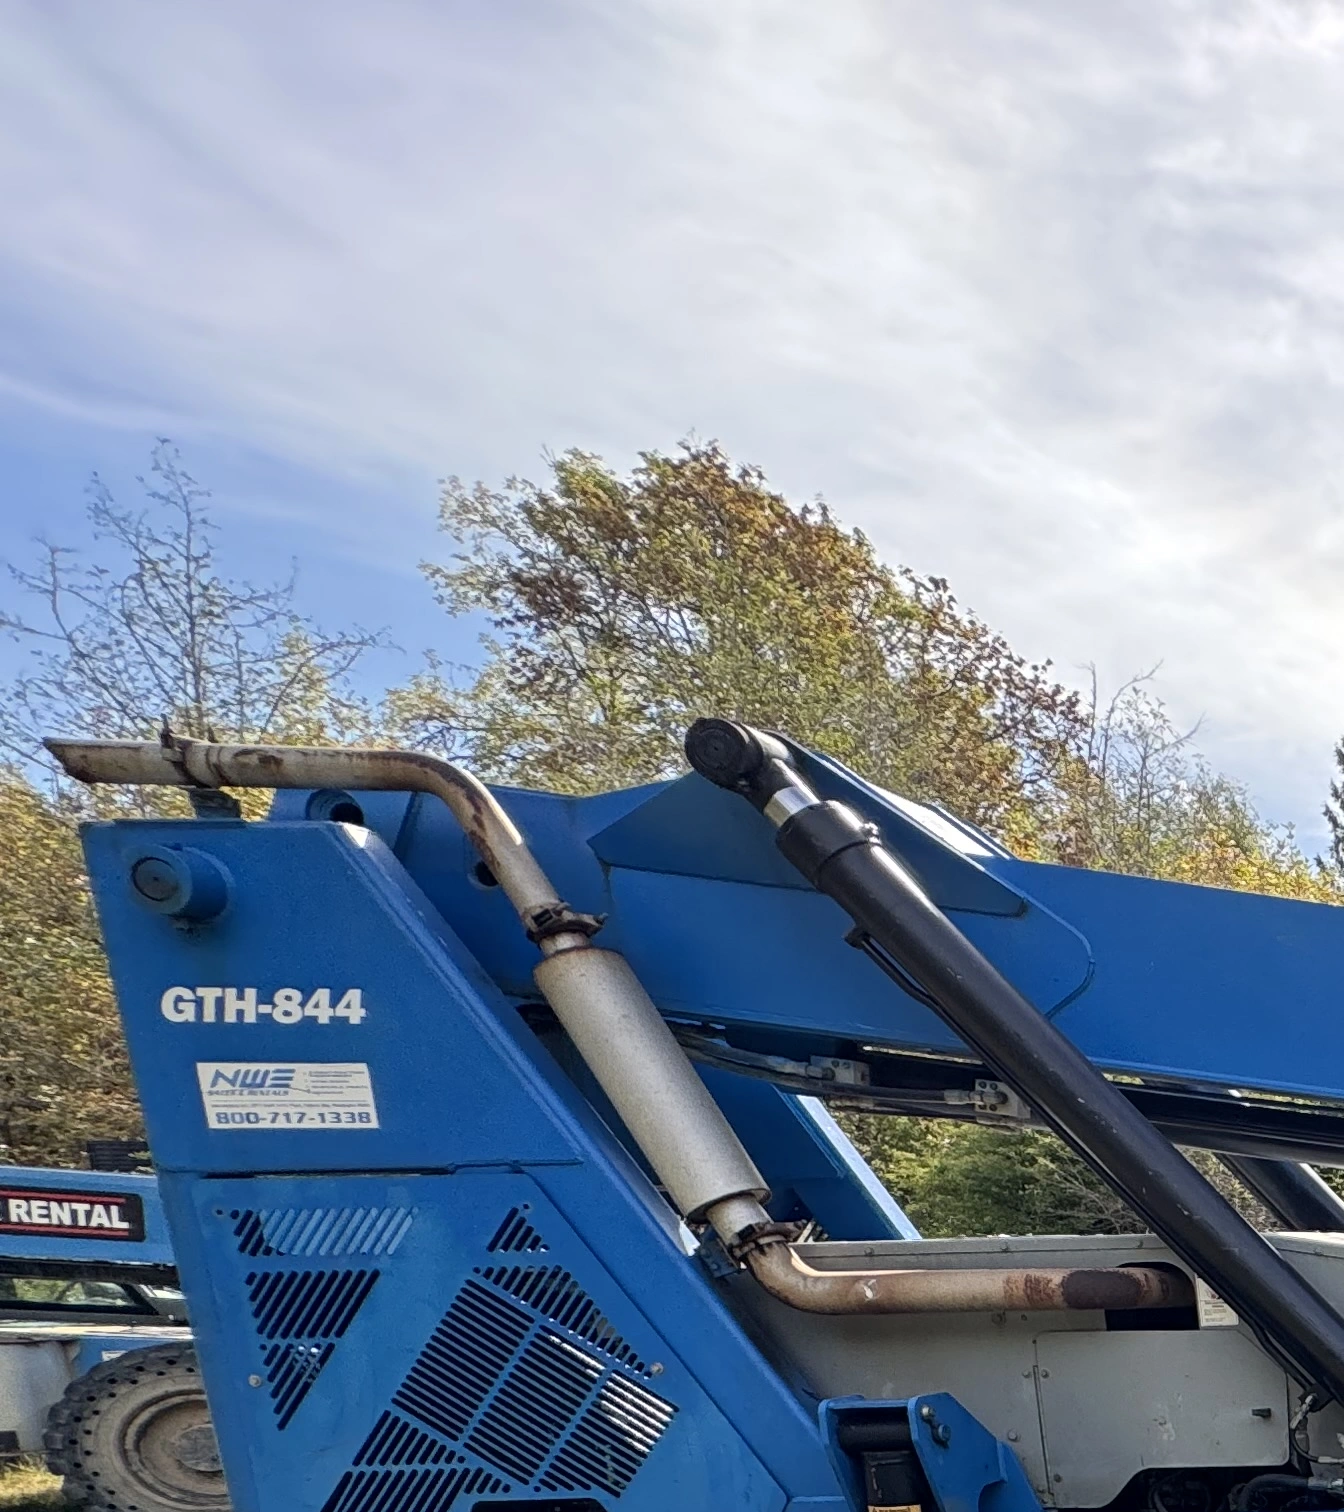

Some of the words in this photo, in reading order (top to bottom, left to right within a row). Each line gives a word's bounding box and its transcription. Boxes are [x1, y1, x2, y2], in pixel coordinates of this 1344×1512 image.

[161, 986, 367, 1024] GTH-844
[210, 1068, 296, 1089] NWE
[215, 1111, 372, 1125] 800-717-1338
[8, 1198, 131, 1229] RENTAL
